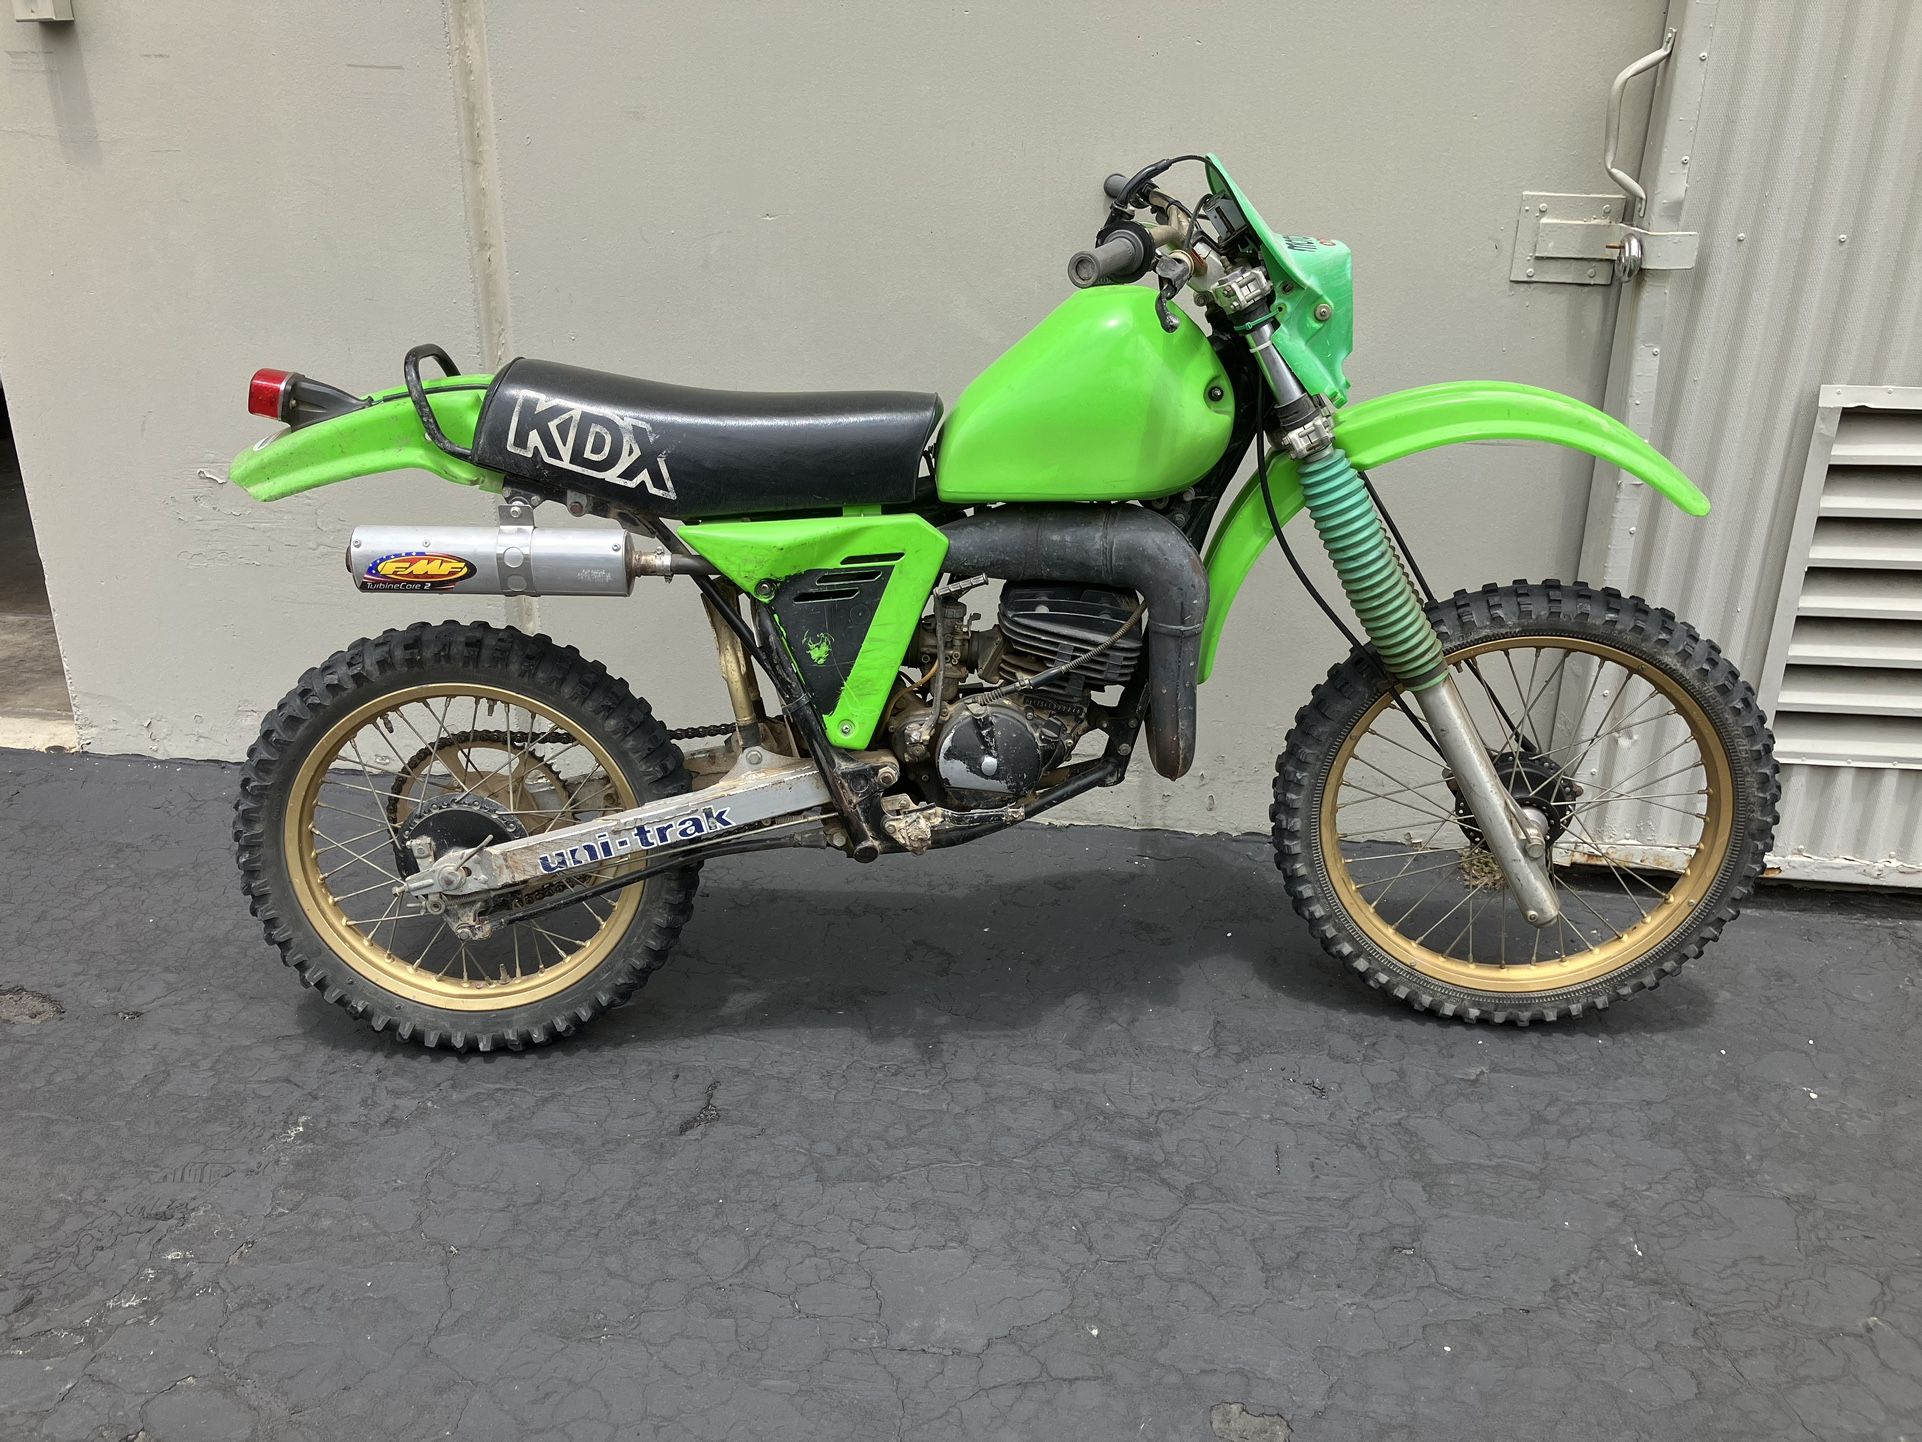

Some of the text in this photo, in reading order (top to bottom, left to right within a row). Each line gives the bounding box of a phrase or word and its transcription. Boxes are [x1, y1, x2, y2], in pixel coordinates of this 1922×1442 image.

[507, 389, 677, 500] KDX
[366, 582, 432, 590] TurbineCore 2
[380, 560, 466, 575] FMF
[538, 805, 736, 874] uni-trak
